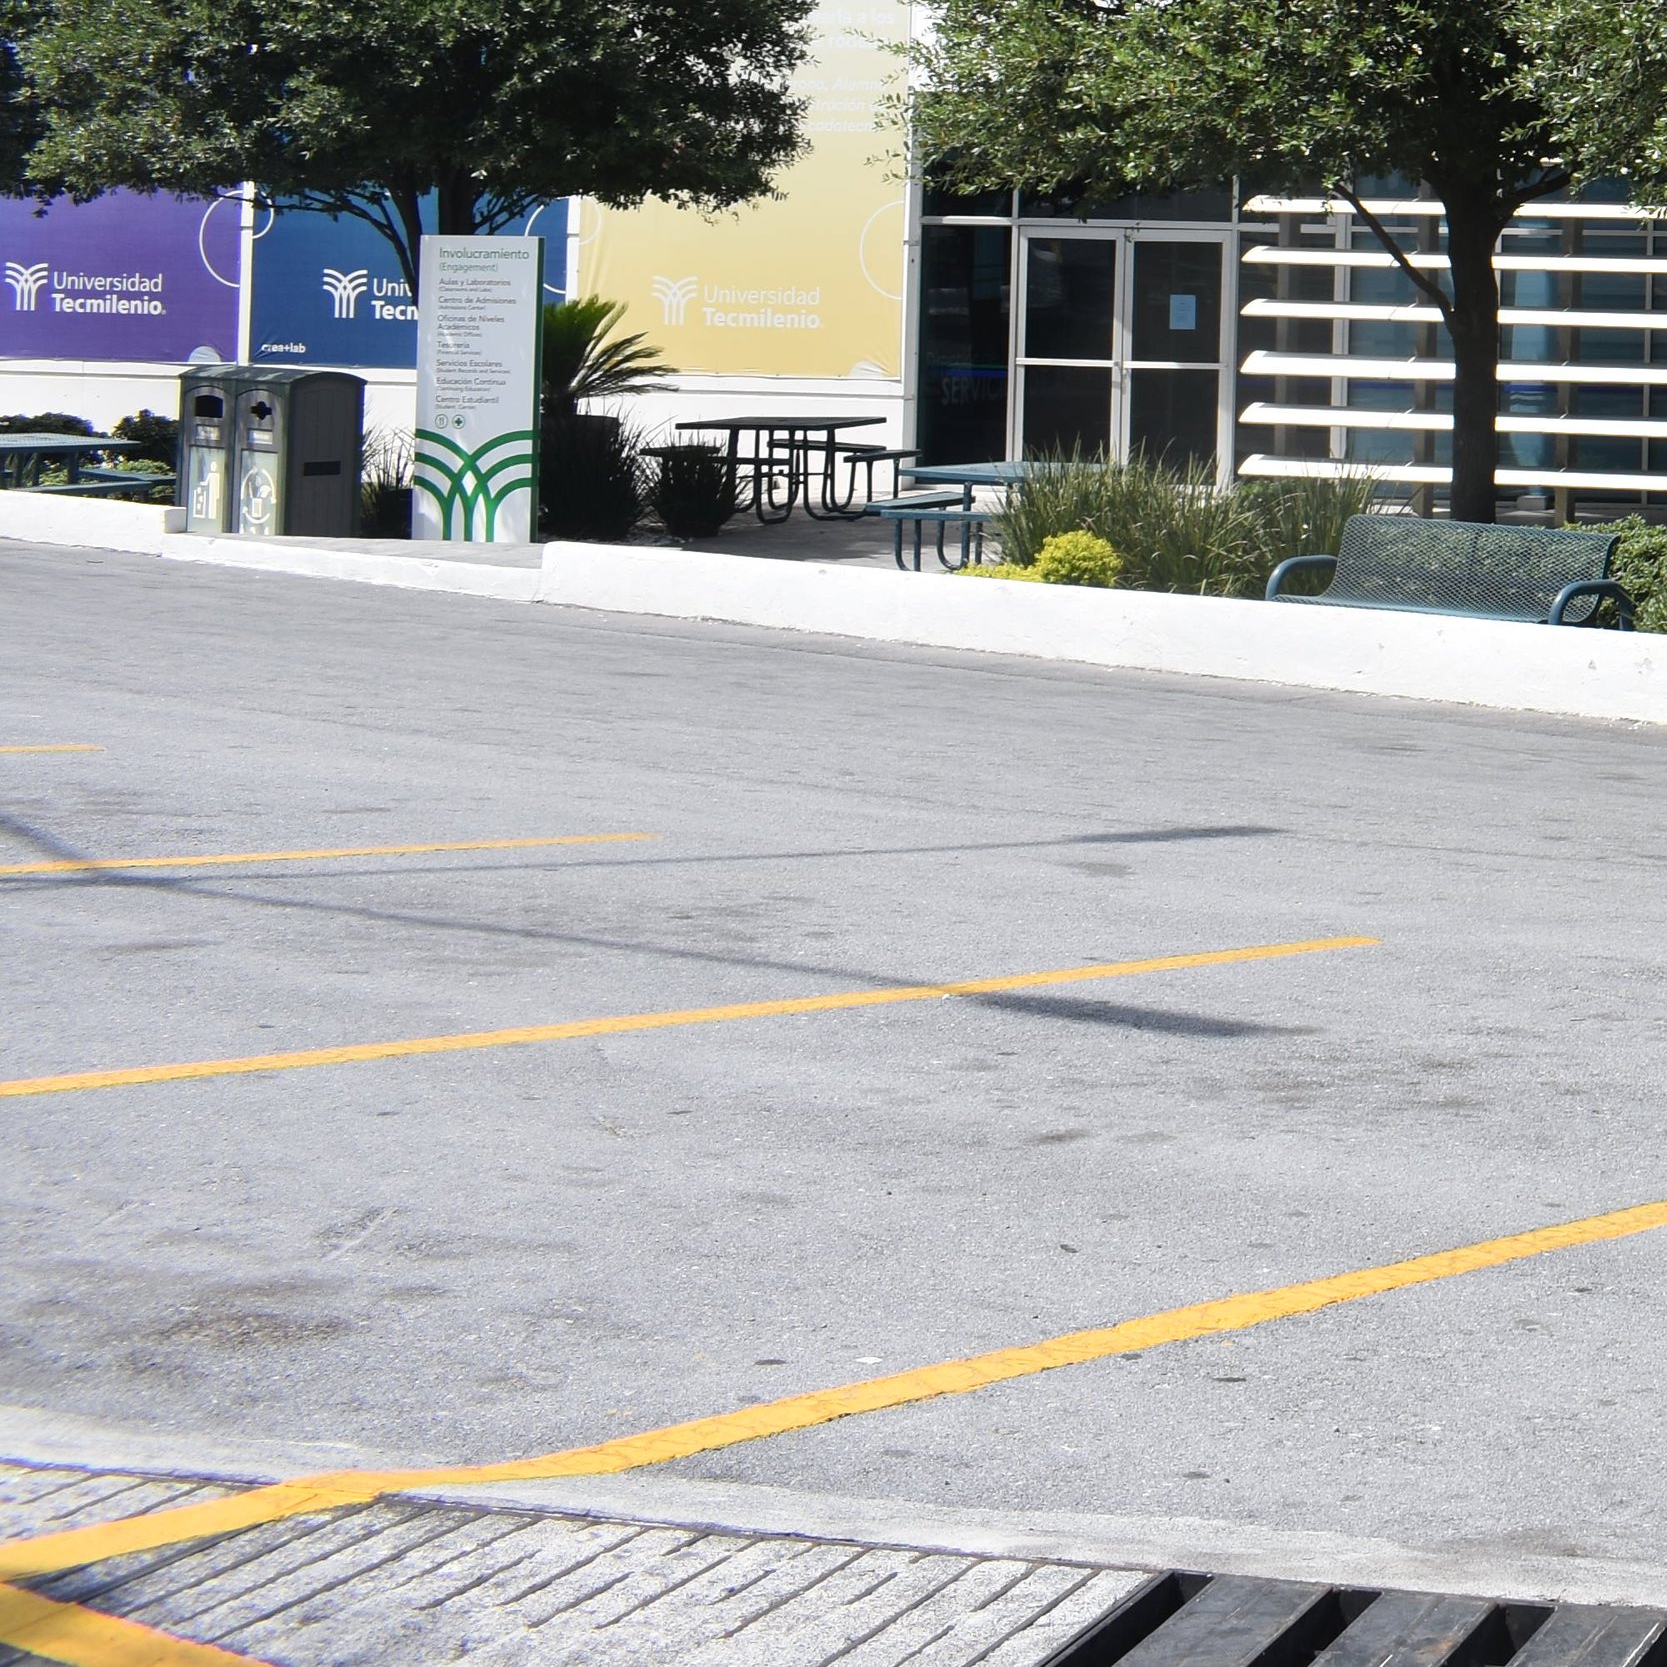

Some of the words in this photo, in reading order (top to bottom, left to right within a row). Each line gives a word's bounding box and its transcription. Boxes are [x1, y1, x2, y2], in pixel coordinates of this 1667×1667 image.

[440, 246, 529, 260] Involucramiento
[440, 262, 498, 274] (Engagement)
[54, 271, 162, 292] Universidad
[51, 293, 163, 315] Tecmilenio
[703, 285, 820, 305] Universidad
[702, 307, 820, 328] Tecmilenio
